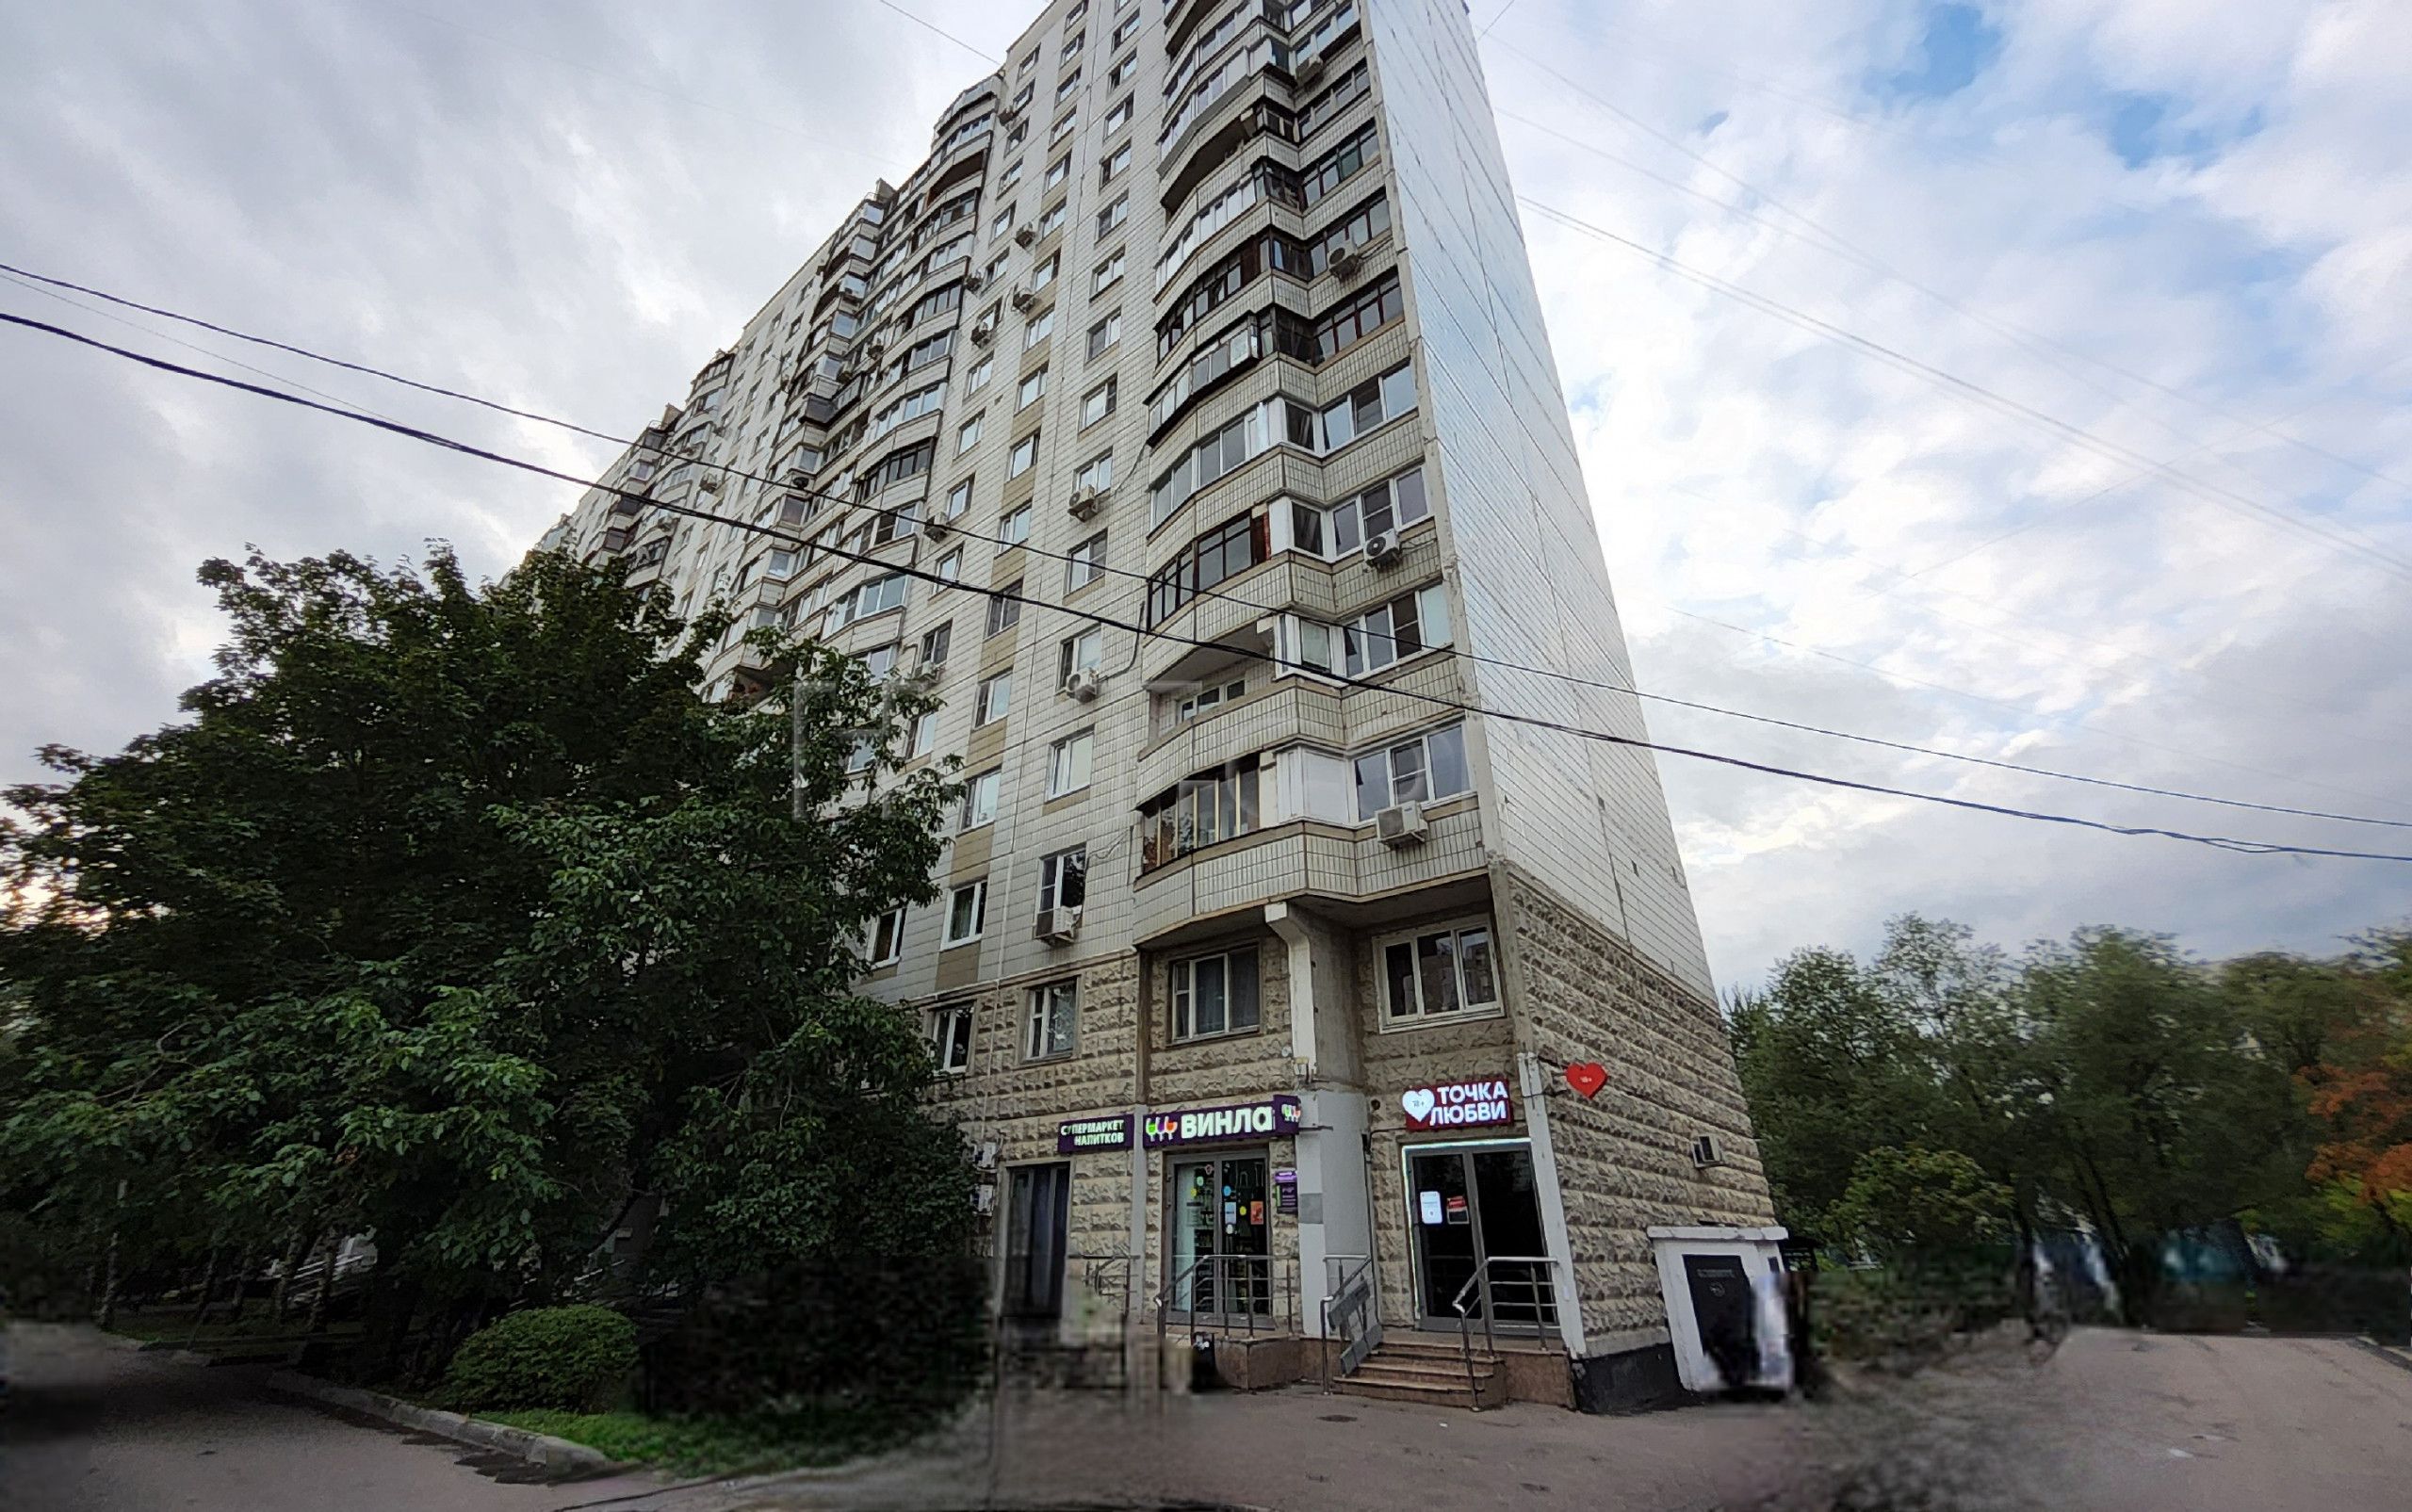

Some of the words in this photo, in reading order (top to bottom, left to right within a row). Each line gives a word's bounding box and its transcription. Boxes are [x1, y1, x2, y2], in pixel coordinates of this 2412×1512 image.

[1437, 1081, 1508, 1105] ТОЧКА
[1429, 1099, 1507, 1127] ЛЮБВИ
[1074, 1131, 1125, 1146] НАПИТКОВ
